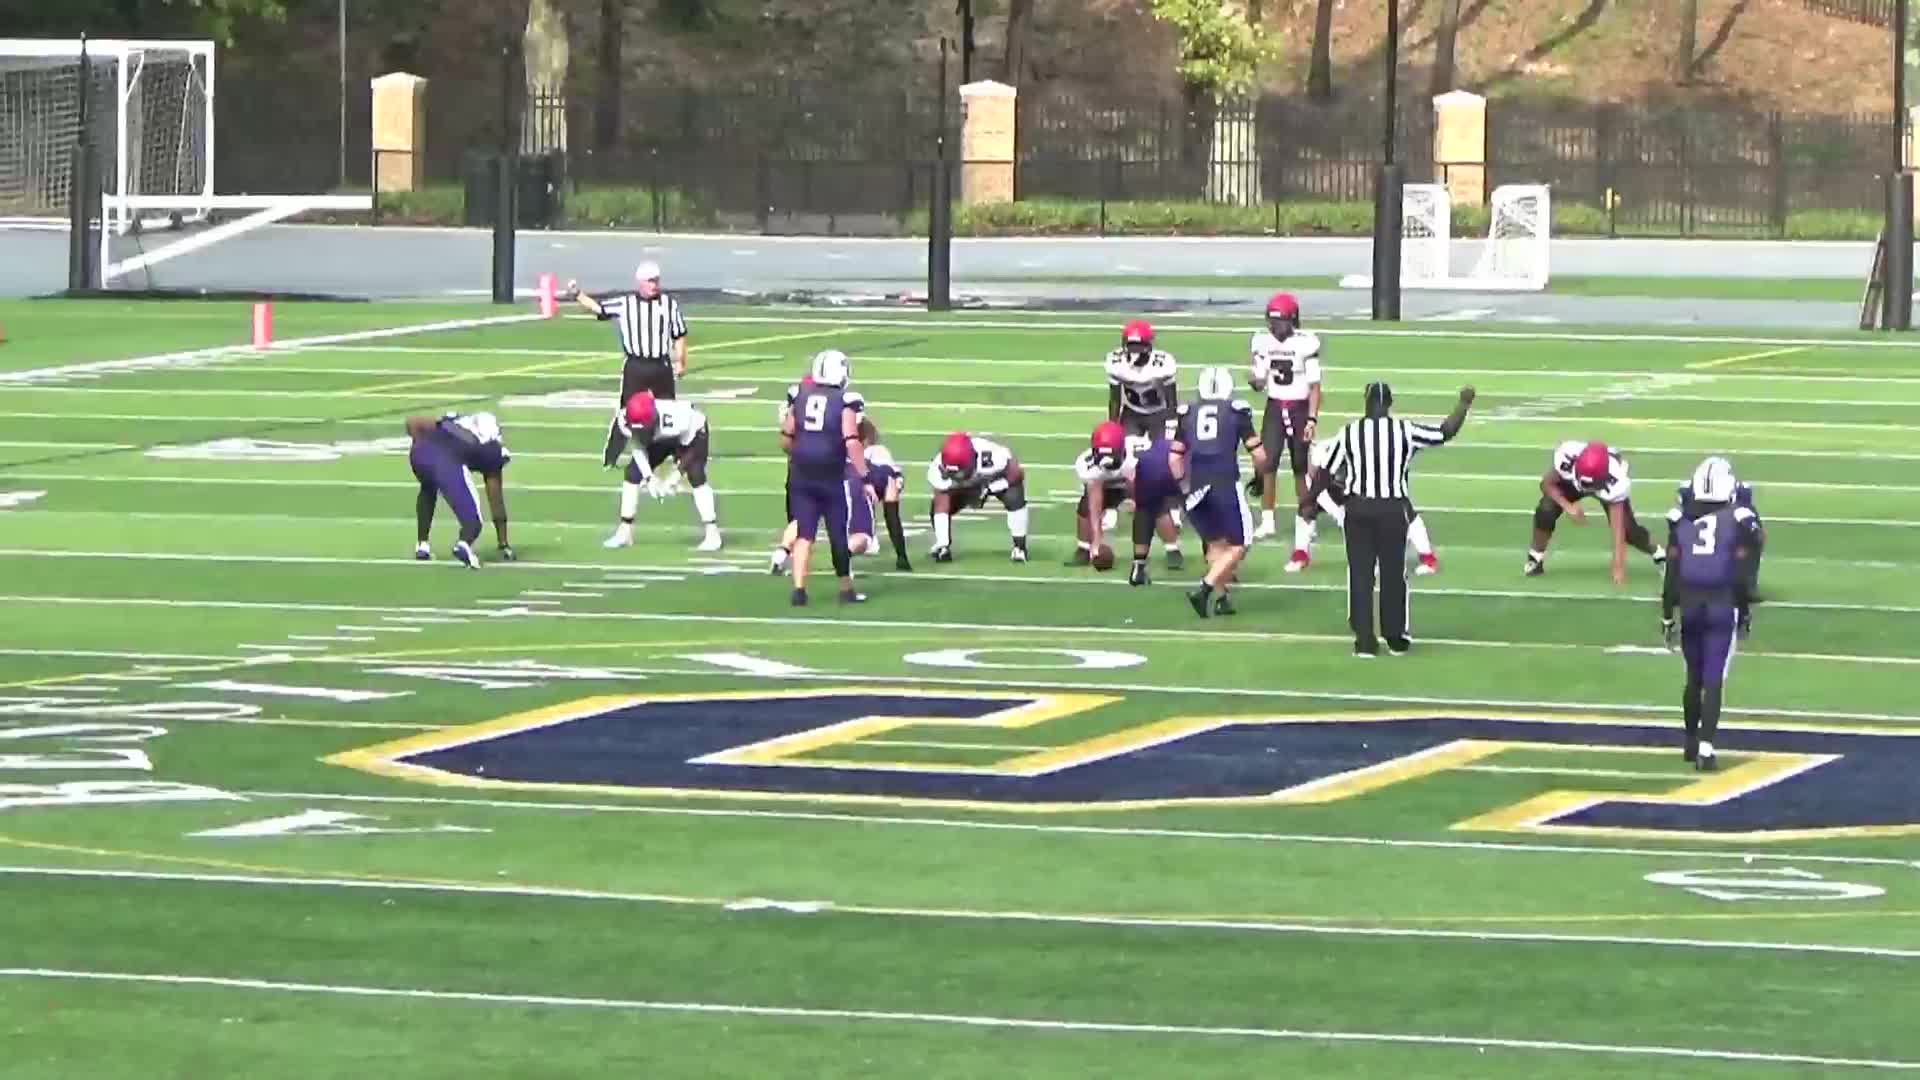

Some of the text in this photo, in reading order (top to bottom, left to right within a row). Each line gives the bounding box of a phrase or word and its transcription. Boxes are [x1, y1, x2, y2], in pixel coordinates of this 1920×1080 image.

[1270, 359, 1294, 386] 3
[804, 395, 828, 431] 9
[1196, 404, 1218, 441] 6
[1692, 515, 1718, 555] 3
